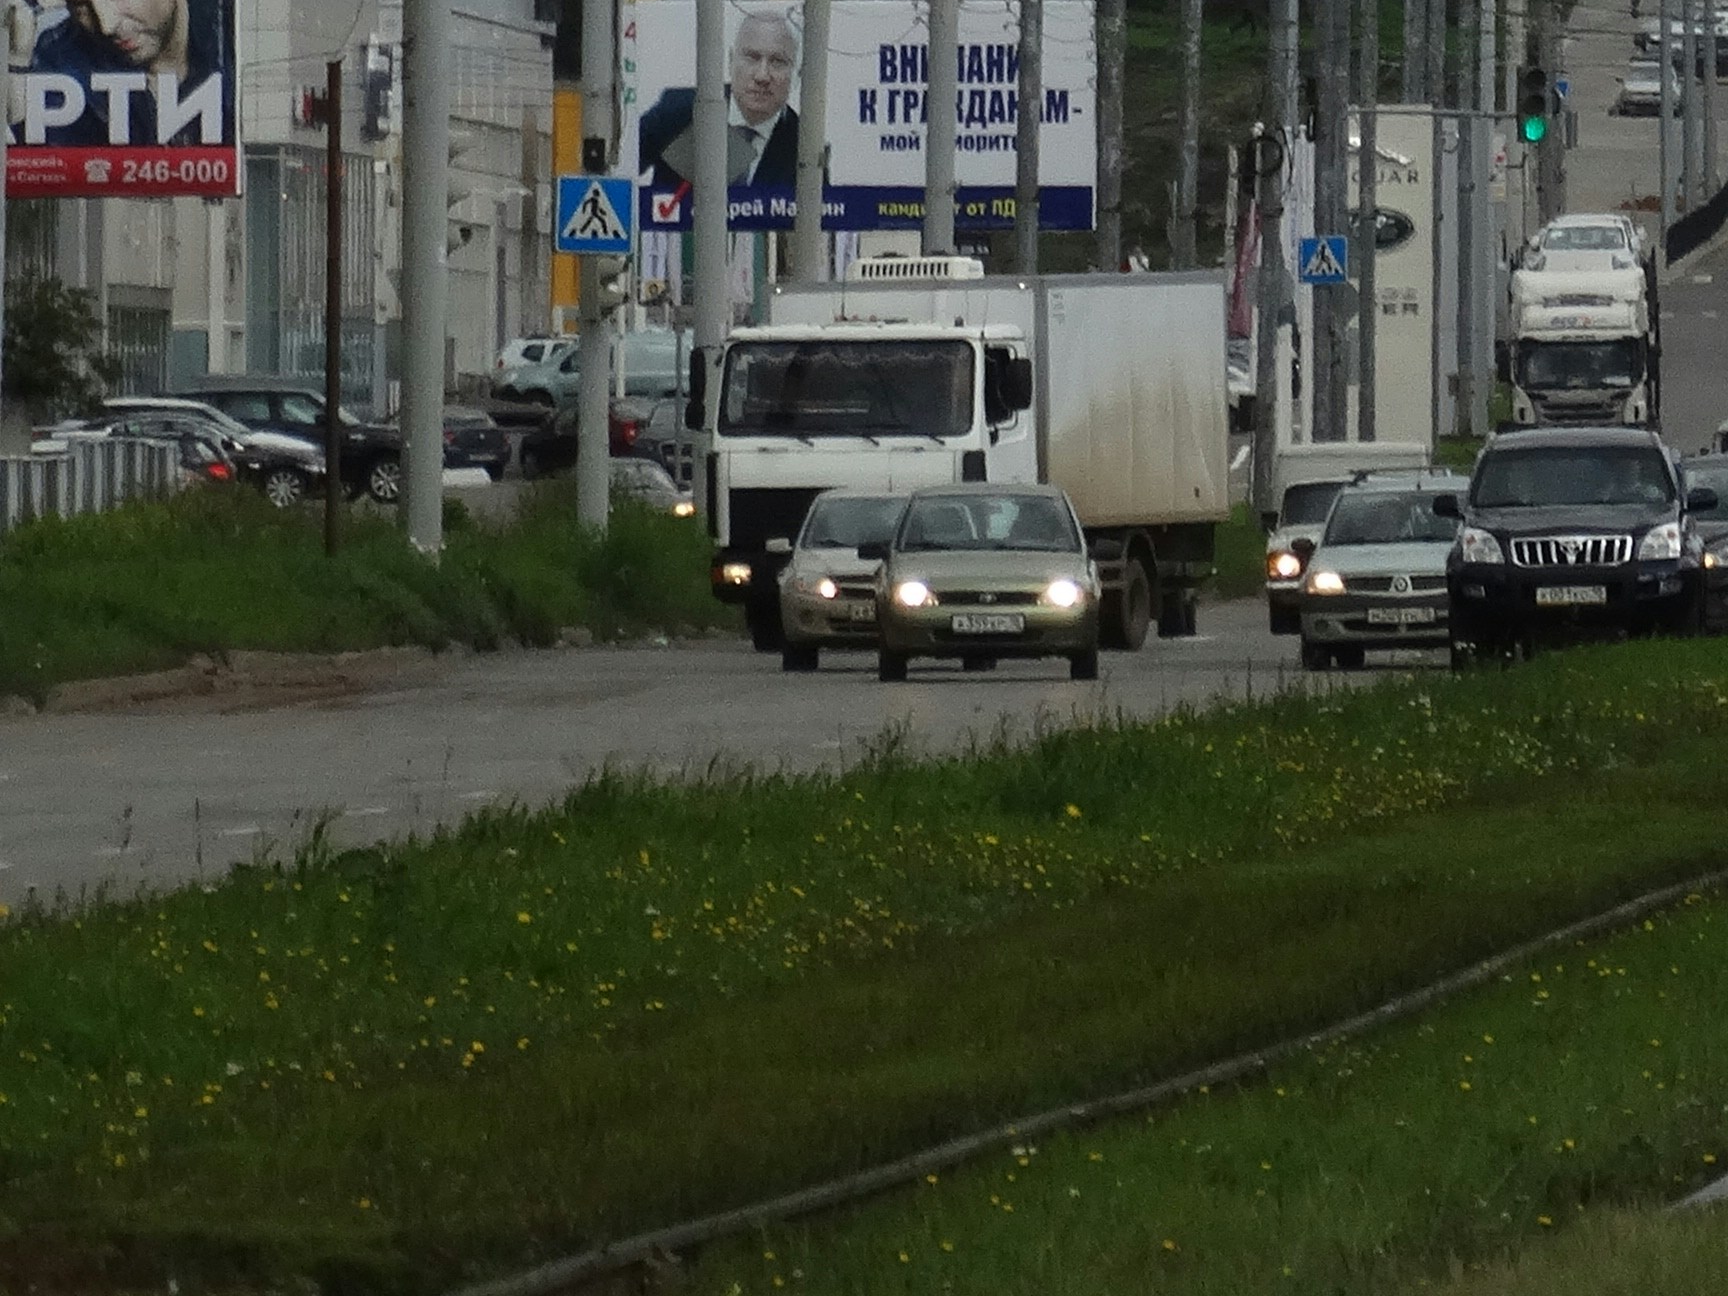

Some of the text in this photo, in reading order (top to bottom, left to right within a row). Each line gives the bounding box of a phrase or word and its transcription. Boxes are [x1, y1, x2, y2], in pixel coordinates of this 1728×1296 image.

[859, 89, 877, 123] К
[880, 133, 920, 151] мой
[122, 159, 228, 184] 246-000
[966, 203, 986, 217] от
